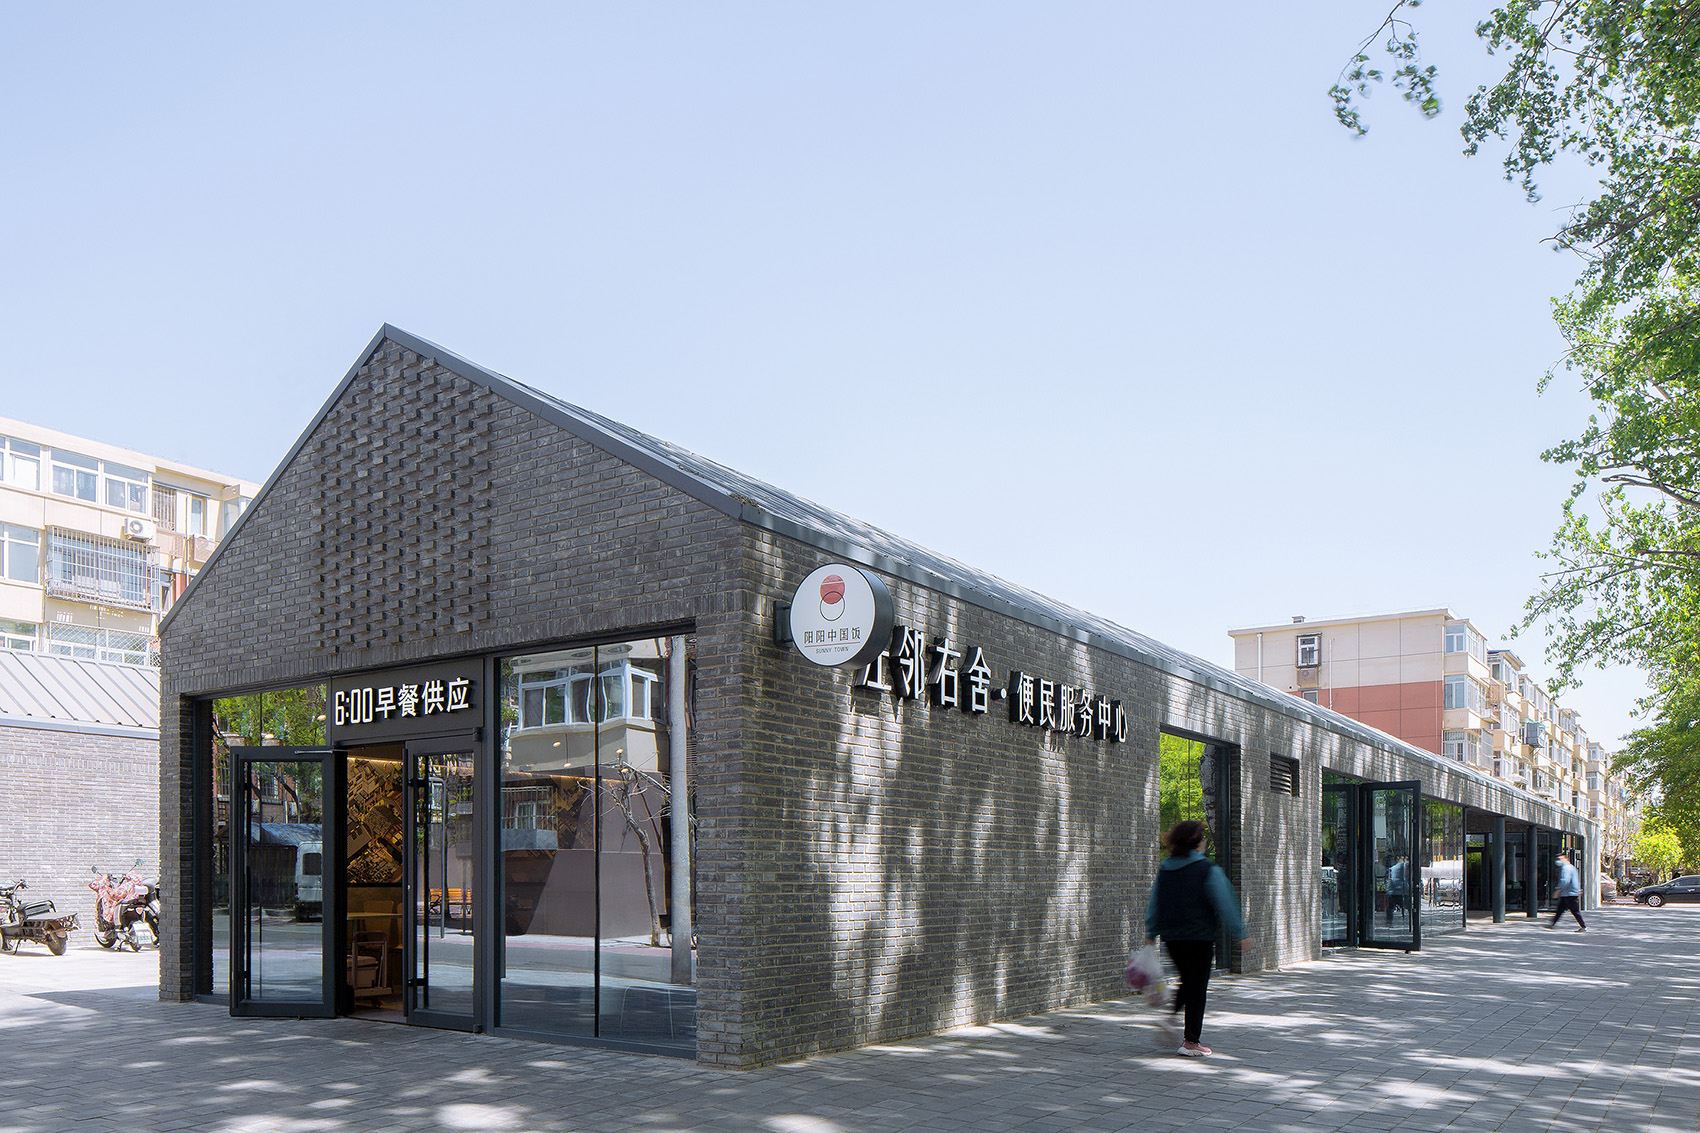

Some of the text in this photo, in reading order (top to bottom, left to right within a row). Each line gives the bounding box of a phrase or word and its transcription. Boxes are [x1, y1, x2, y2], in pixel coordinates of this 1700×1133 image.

[804, 627, 860, 643] 阳阳中国饭
[335, 677, 469, 725] 6:00早餐供应
